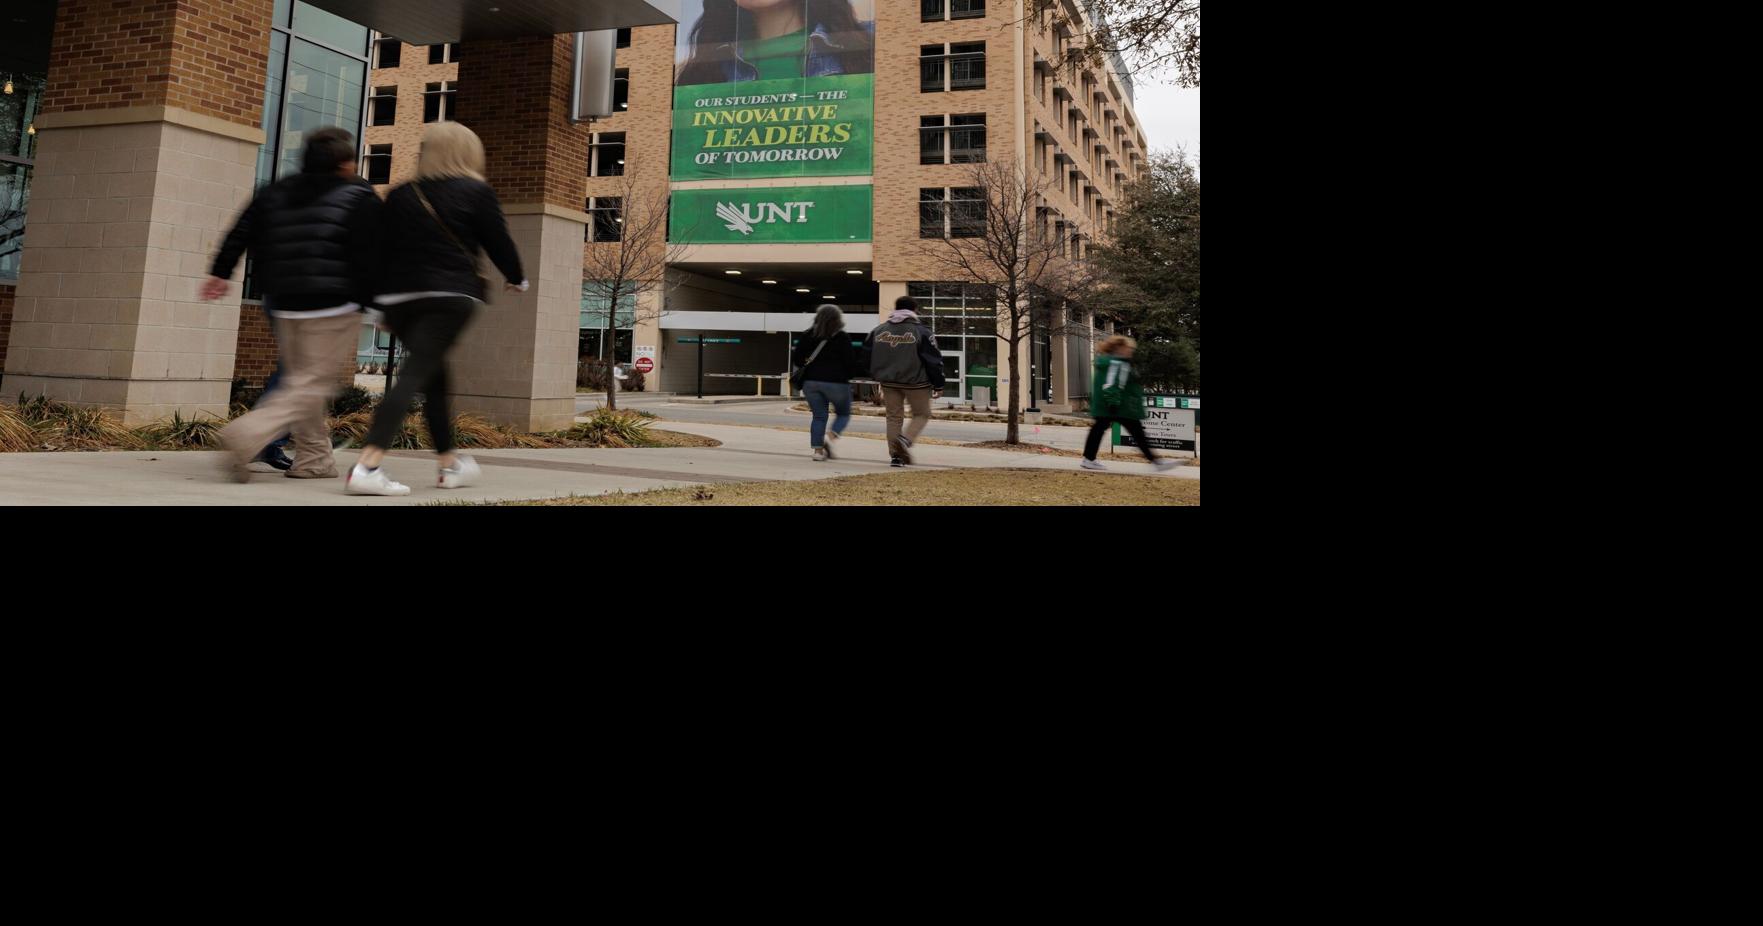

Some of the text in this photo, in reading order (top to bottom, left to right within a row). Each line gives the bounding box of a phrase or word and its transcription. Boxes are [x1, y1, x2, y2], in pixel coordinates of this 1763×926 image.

[695, 97, 725, 108] OUR
[725, 93, 797, 106] STUDENTS
[817, 90, 848, 100] THE
[692, 105, 838, 127] INNOVATIVE
[703, 123, 852, 148] LEADERS
[695, 147, 844, 165] OF TOMORROW
[741, 201, 813, 223] UNT
[1160, 420, 1186, 428] Center
